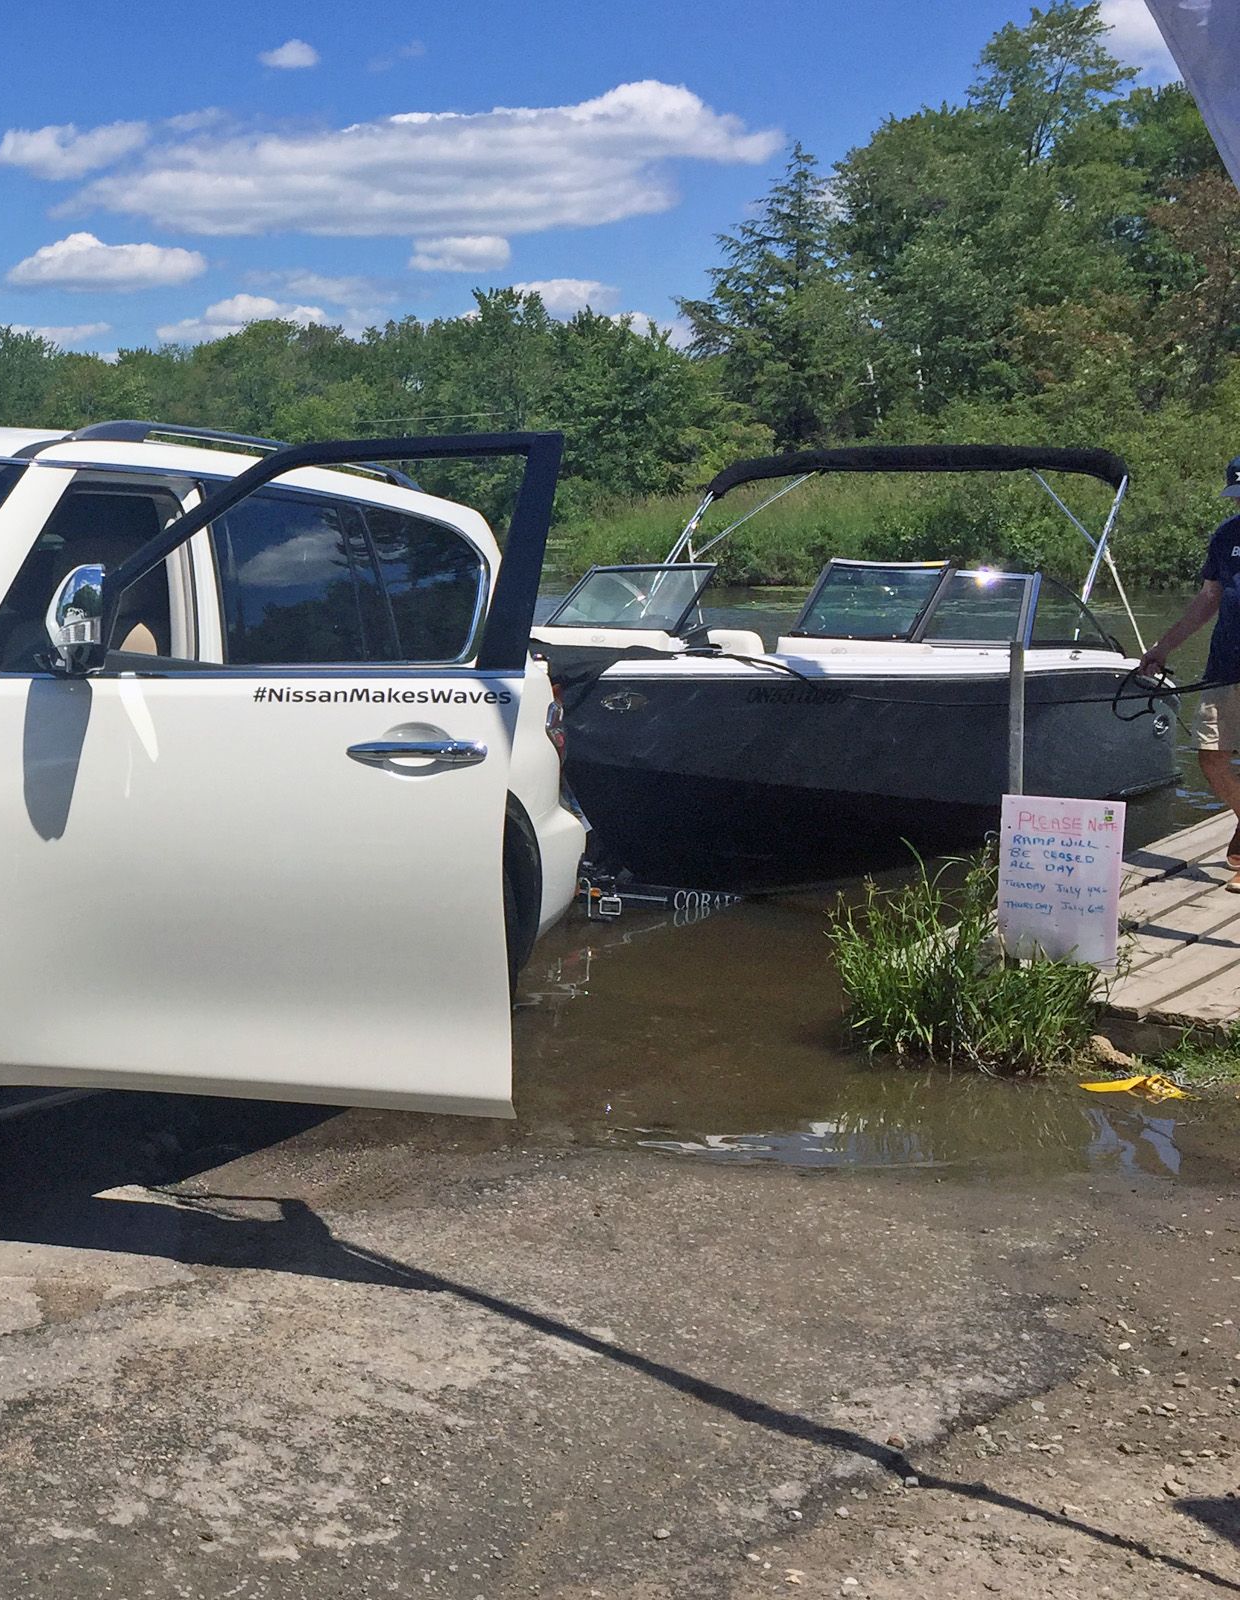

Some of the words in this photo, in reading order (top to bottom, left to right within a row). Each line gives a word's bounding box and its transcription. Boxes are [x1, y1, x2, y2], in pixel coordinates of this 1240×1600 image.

[253, 686, 512, 705] #NissanMakesWaves
[1018, 810, 1082, 832] PLEASE
[1012, 834, 1056, 846] RAMP
[1060, 837, 1099, 849] WILL
[1009, 847, 1032, 858] BE
[1043, 850, 1094, 864] CLOSED
[1010, 860, 1034, 870] ALL
[1045, 863, 1075, 877] DAY
[673, 890, 742, 911] COB
